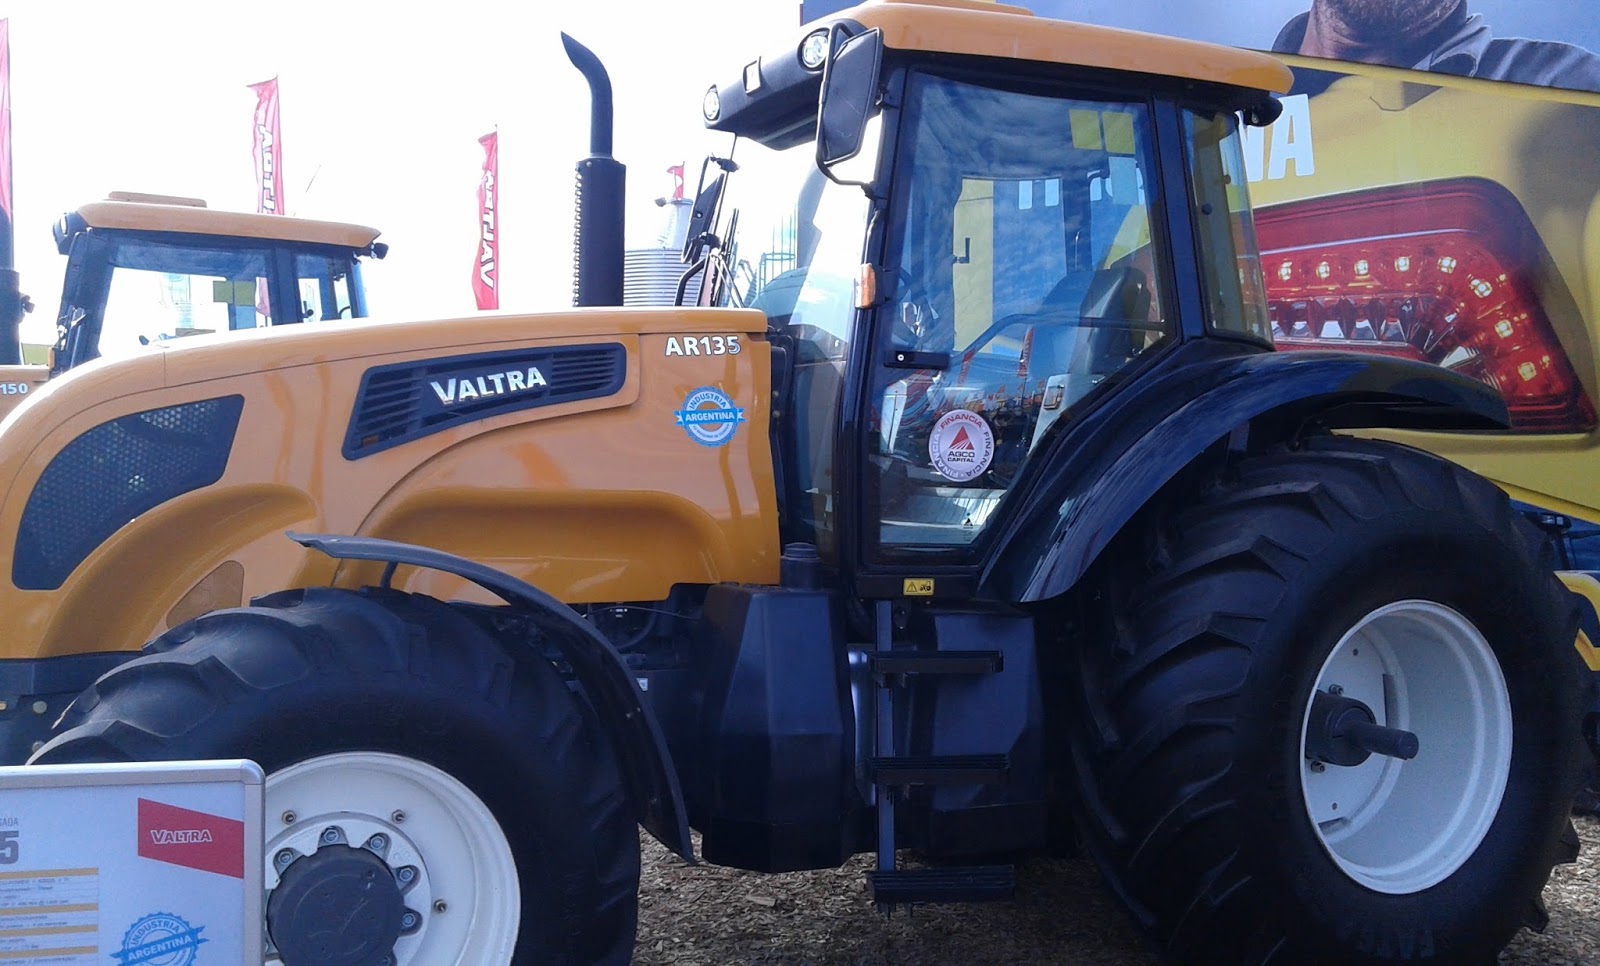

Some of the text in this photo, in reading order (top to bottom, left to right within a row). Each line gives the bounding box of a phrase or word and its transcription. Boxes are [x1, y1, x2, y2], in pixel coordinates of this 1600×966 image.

[665, 335, 741, 356] AR135
[0, 382, 29, 395] 150
[430, 366, 547, 405] VALTRA
[689, 392, 727, 410] INDUSTRIA
[684, 411, 736, 422] ARGENTINA
[940, 413, 983, 430] FINANCIA
[932, 433, 960, 478] FINANCIA
[947, 450, 976, 458] AGCO
[966, 431, 991, 477] FINANCIA
[150, 829, 213, 845] VALTRA
[130, 919, 180, 945] INDUSTRIA
[127, 935, 193, 962] ARGENTINA
